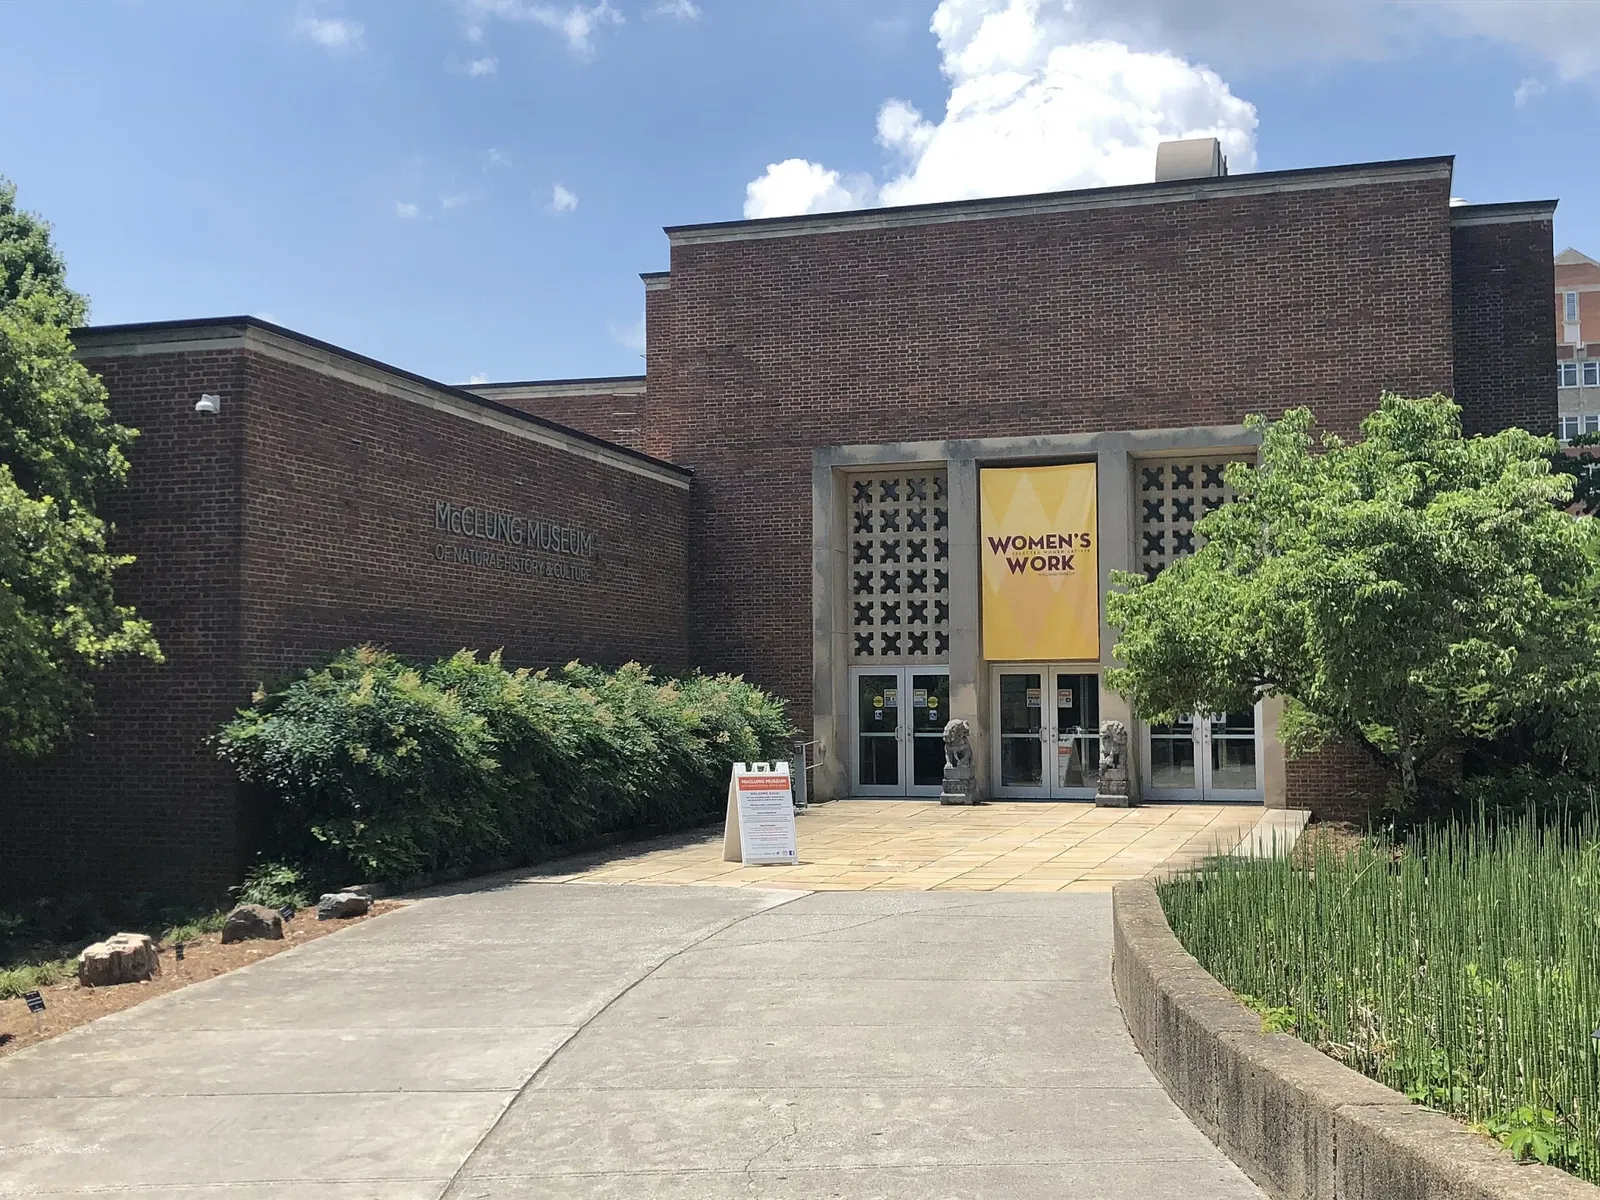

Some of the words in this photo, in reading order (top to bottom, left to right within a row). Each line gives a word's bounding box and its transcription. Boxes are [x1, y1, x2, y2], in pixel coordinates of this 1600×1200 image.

[435, 500, 523, 544] McCLUNG
[527, 519, 592, 557] MUSEUM
[987, 533, 1091, 555] WOMEN'S
[435, 543, 450, 561] OF
[453, 547, 501, 569] NATURAL
[504, 556, 544, 575] HISTORY
[545, 562, 553, 577] &
[554, 563, 591, 582] CULTURE
[1005, 555, 1075, 575] WORK
